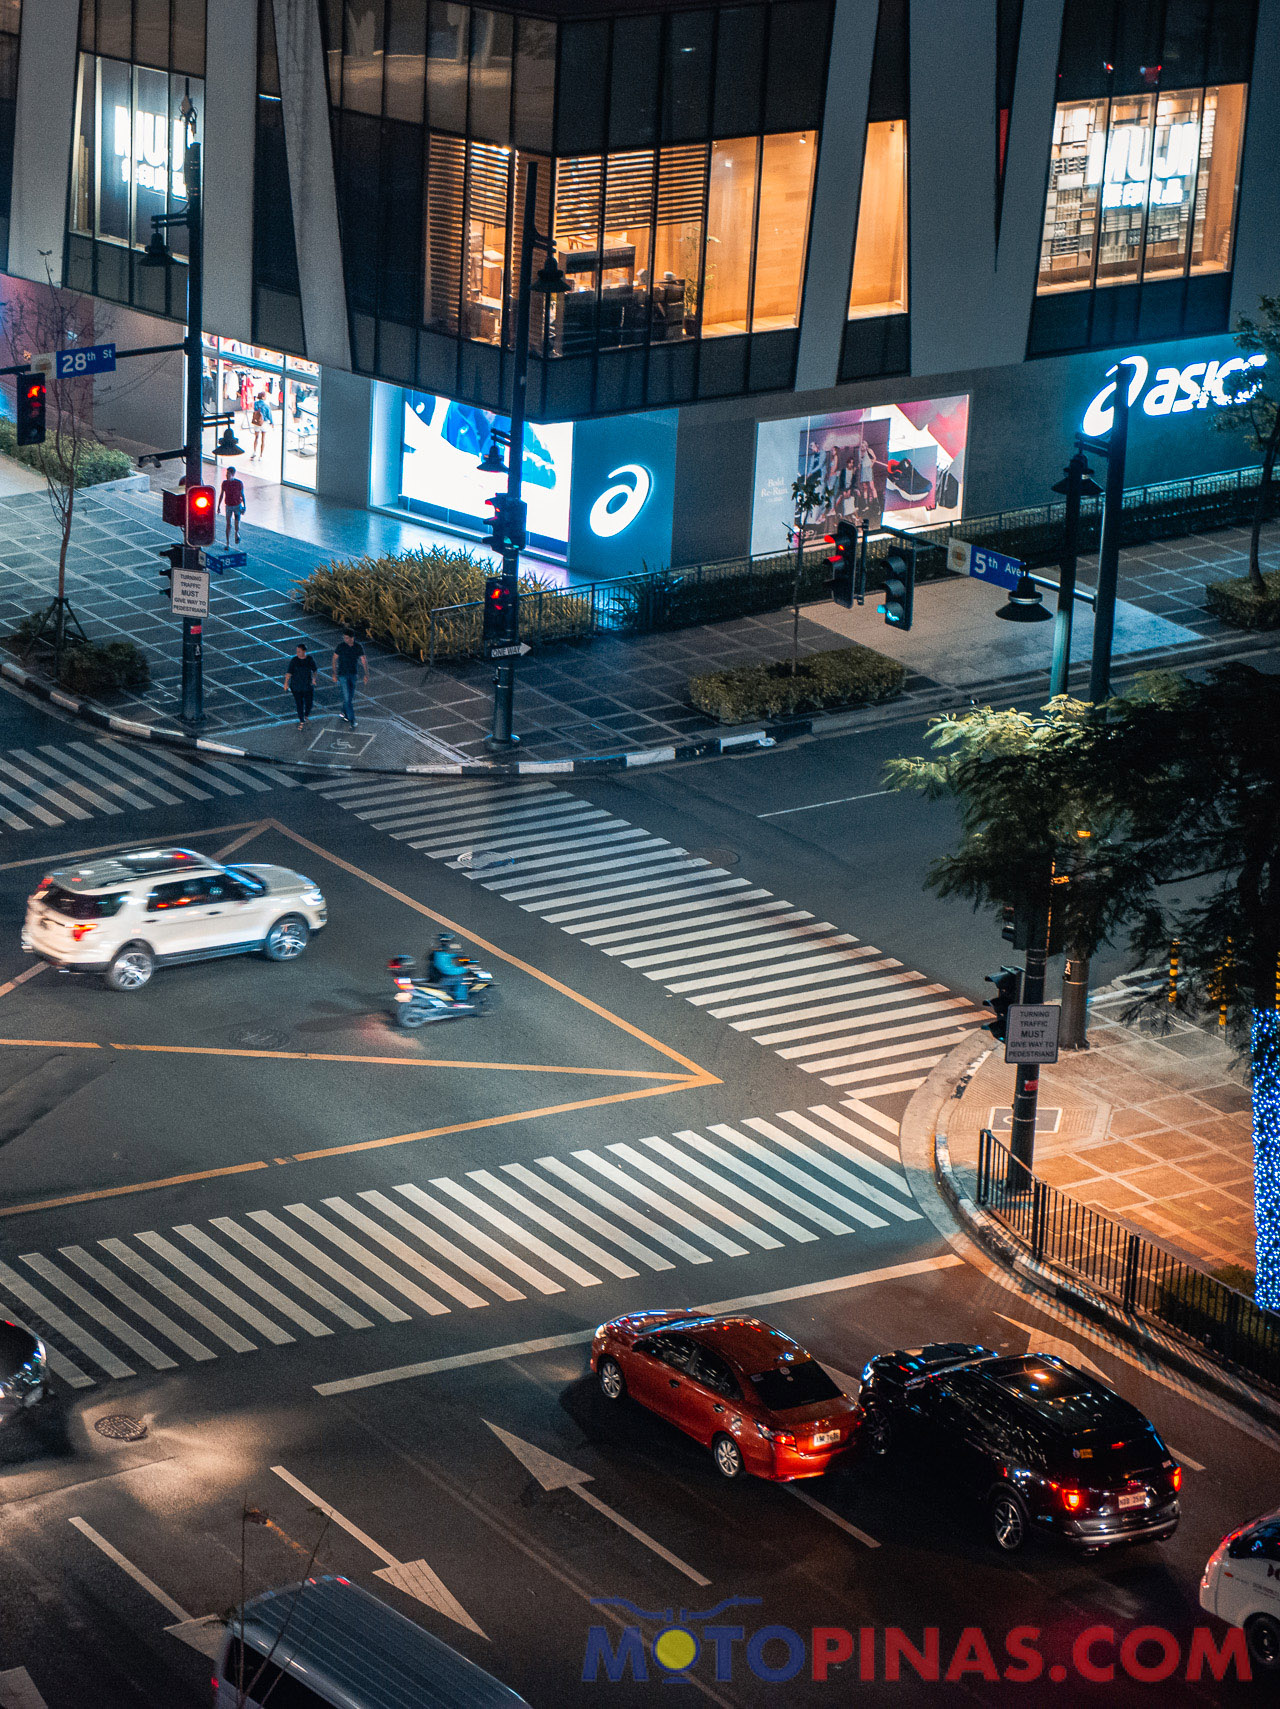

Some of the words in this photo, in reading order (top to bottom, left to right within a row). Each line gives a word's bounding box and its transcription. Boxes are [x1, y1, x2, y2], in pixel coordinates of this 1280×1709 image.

[62, 351, 96, 373] 28th
[102, 348, 113, 359] St
[974, 551, 998, 574] 5th
[1004, 562, 1022, 577] Ave
[180, 573, 202, 581] TURNING
[180, 581, 201, 589] TRAFFIC
[181, 589, 199, 598] MUST
[173, 604, 207, 613] PEDESTRIANS
[1021, 1030, 1045, 1038] MUST
[1008, 1050, 1055, 1058] PEDESTRIANS
